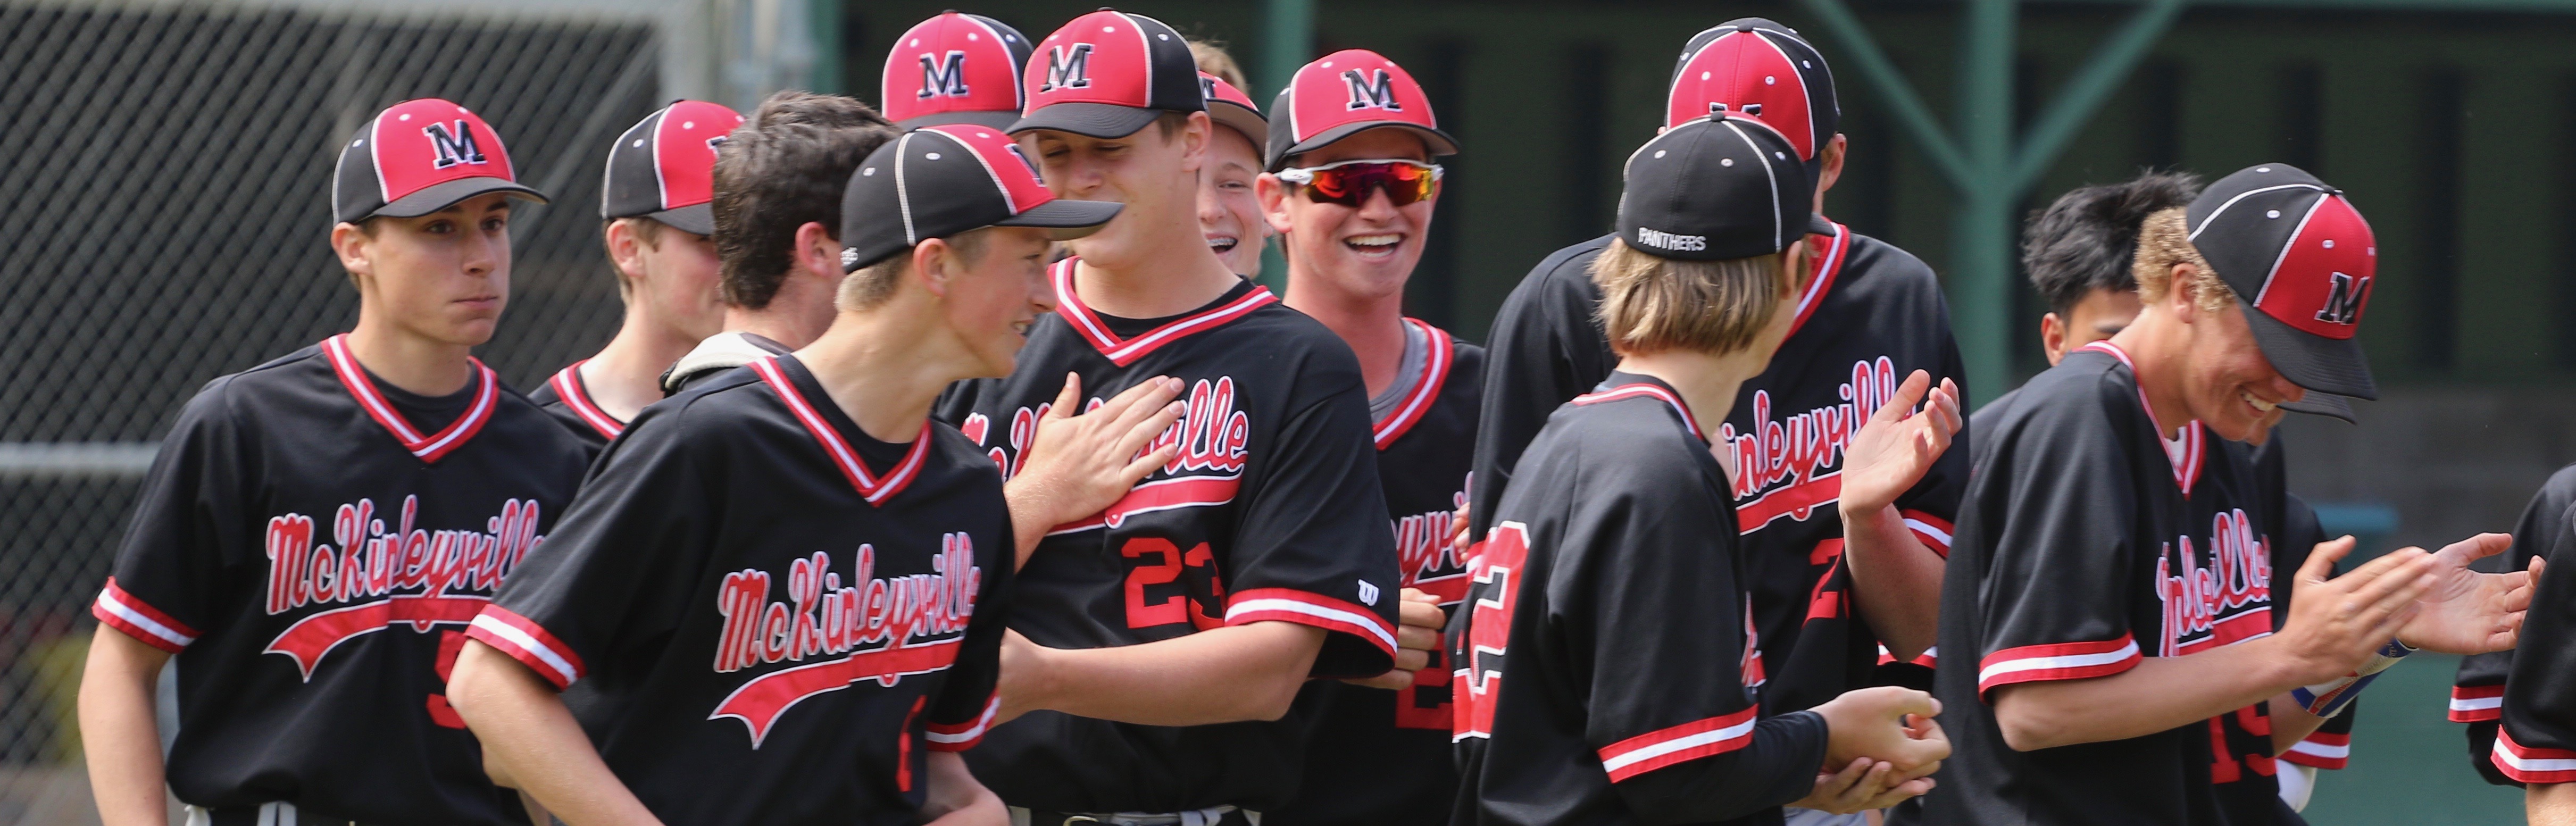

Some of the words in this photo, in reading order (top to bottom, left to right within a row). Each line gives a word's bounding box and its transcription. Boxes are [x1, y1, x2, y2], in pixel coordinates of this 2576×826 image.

[918, 50, 969, 100] M
[1039, 42, 1094, 94] M
[1340, 68, 1403, 112] M
[422, 119, 488, 169] M
[1638, 227, 1706, 251] PANTHERS
[2314, 271, 2370, 326] M
[266, 495, 548, 633] McKinleyvill
